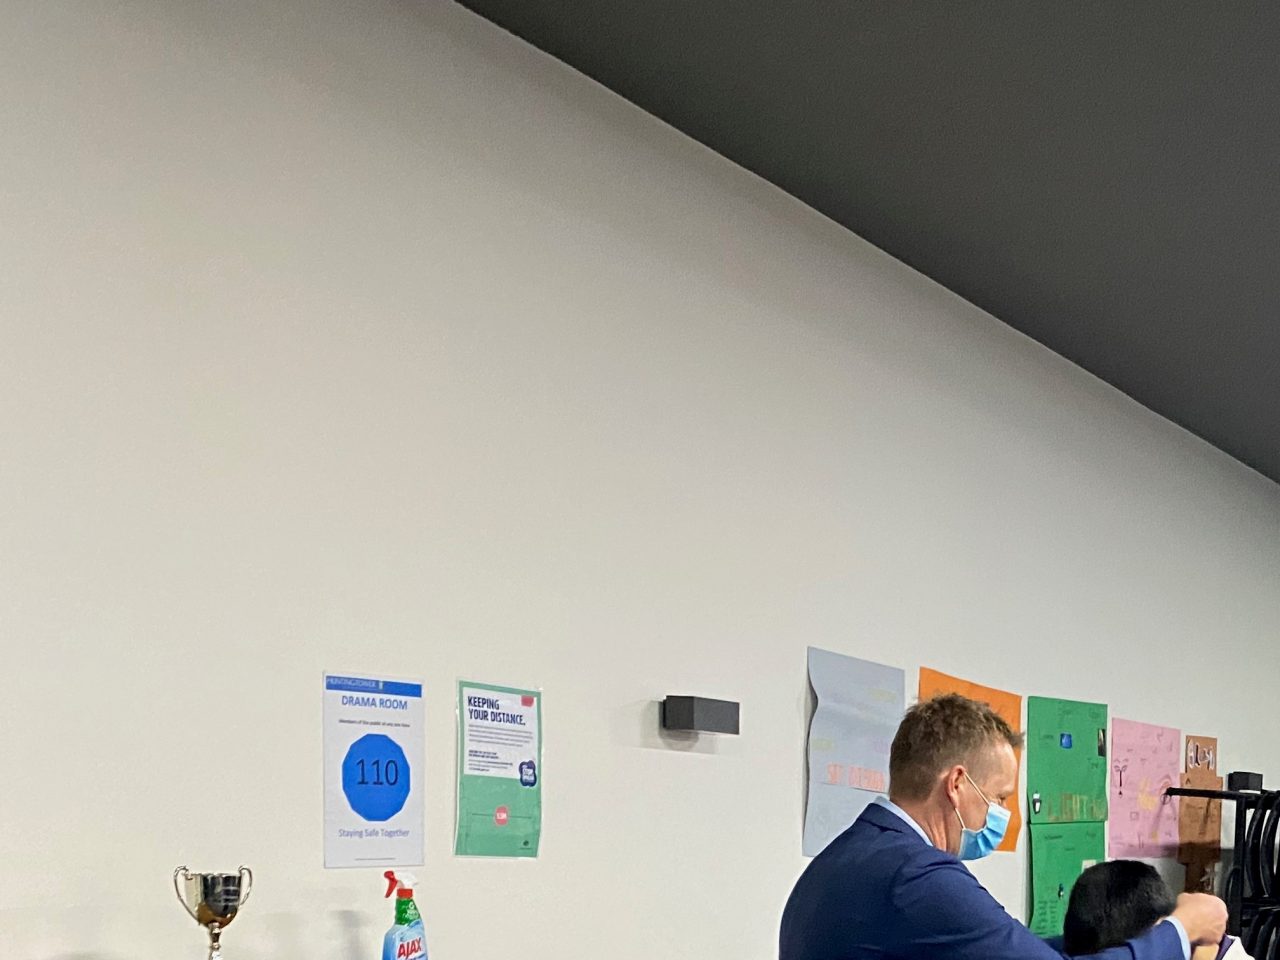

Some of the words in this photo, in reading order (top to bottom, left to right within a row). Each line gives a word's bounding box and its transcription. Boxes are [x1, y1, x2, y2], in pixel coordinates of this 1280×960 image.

[342, 696, 377, 708] DRAMA
[379, 697, 408, 710] ROOM
[467, 695, 500, 710] KEEPING
[468, 708, 489, 721] YOUR
[490, 711, 526, 726] DISTANCE.
[356, 758, 399, 786] 110
[339, 828, 363, 838] Staying
[364, 828, 380, 838] Safe
[380, 829, 409, 838] Together
[398, 937, 421, 959] AJAX
